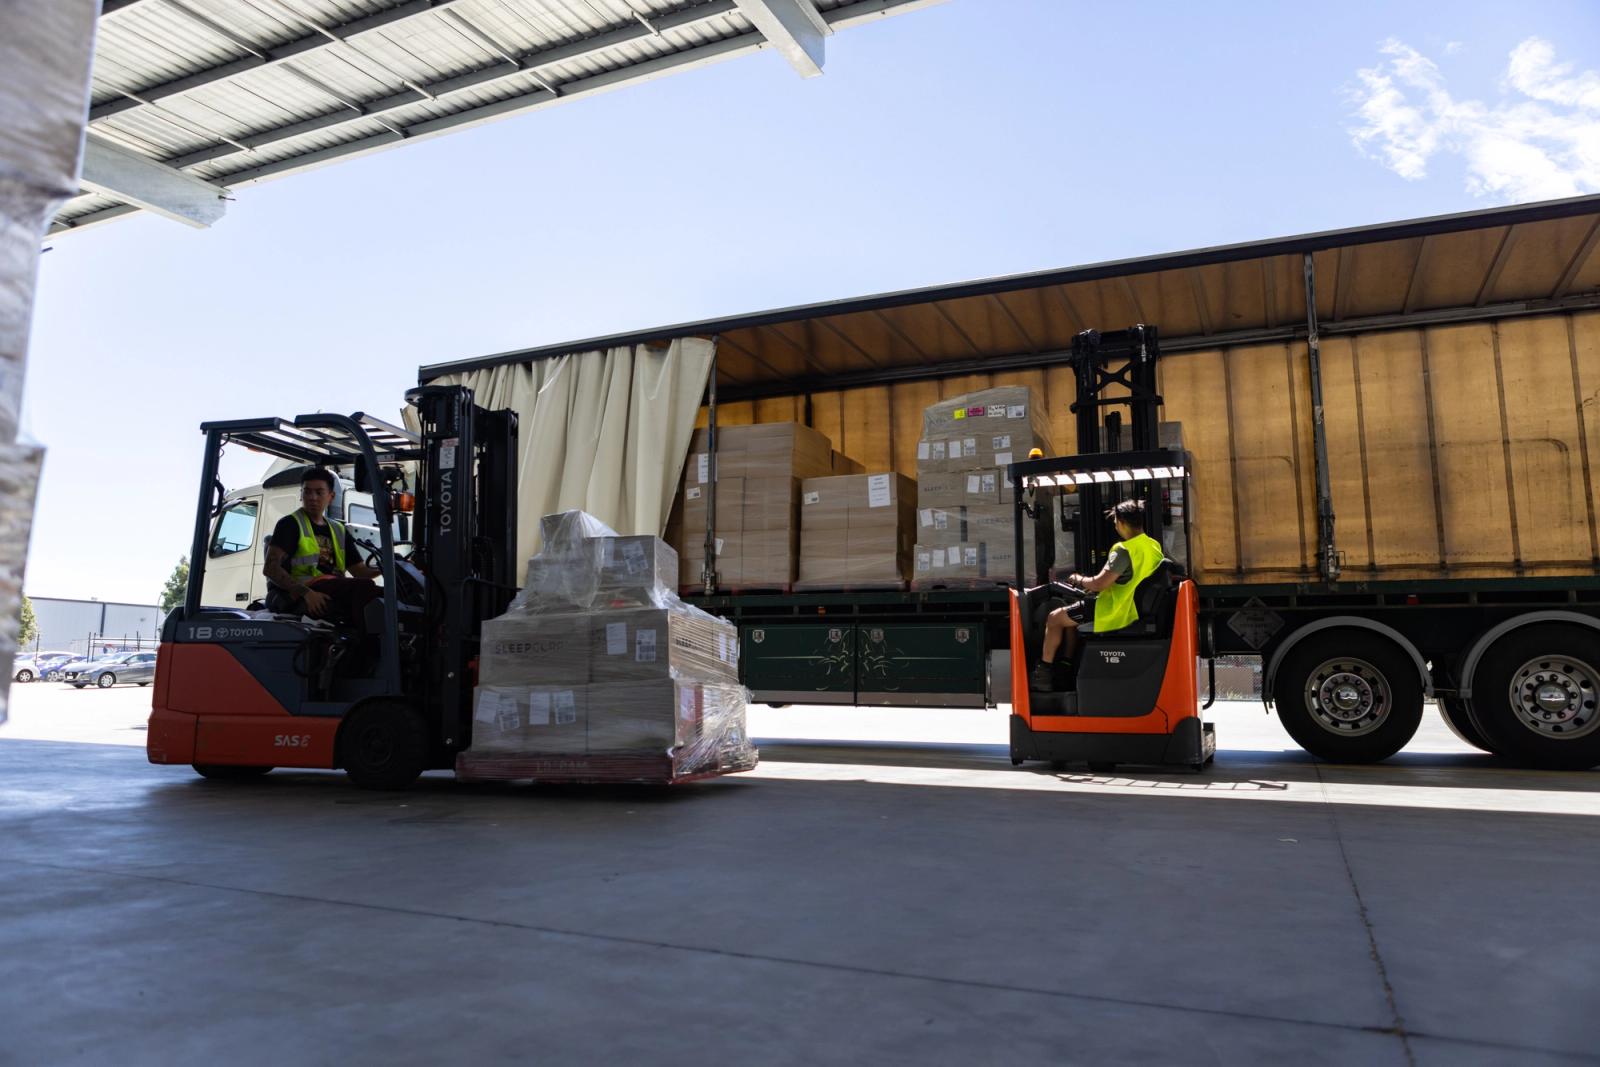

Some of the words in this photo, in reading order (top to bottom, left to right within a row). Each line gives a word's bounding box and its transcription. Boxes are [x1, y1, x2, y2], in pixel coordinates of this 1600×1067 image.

[440, 470, 452, 536] TOYOTA
[188, 626, 213, 639] 18
[230, 627, 264, 637] TOYOTA
[1105, 656, 1120, 664] 16
